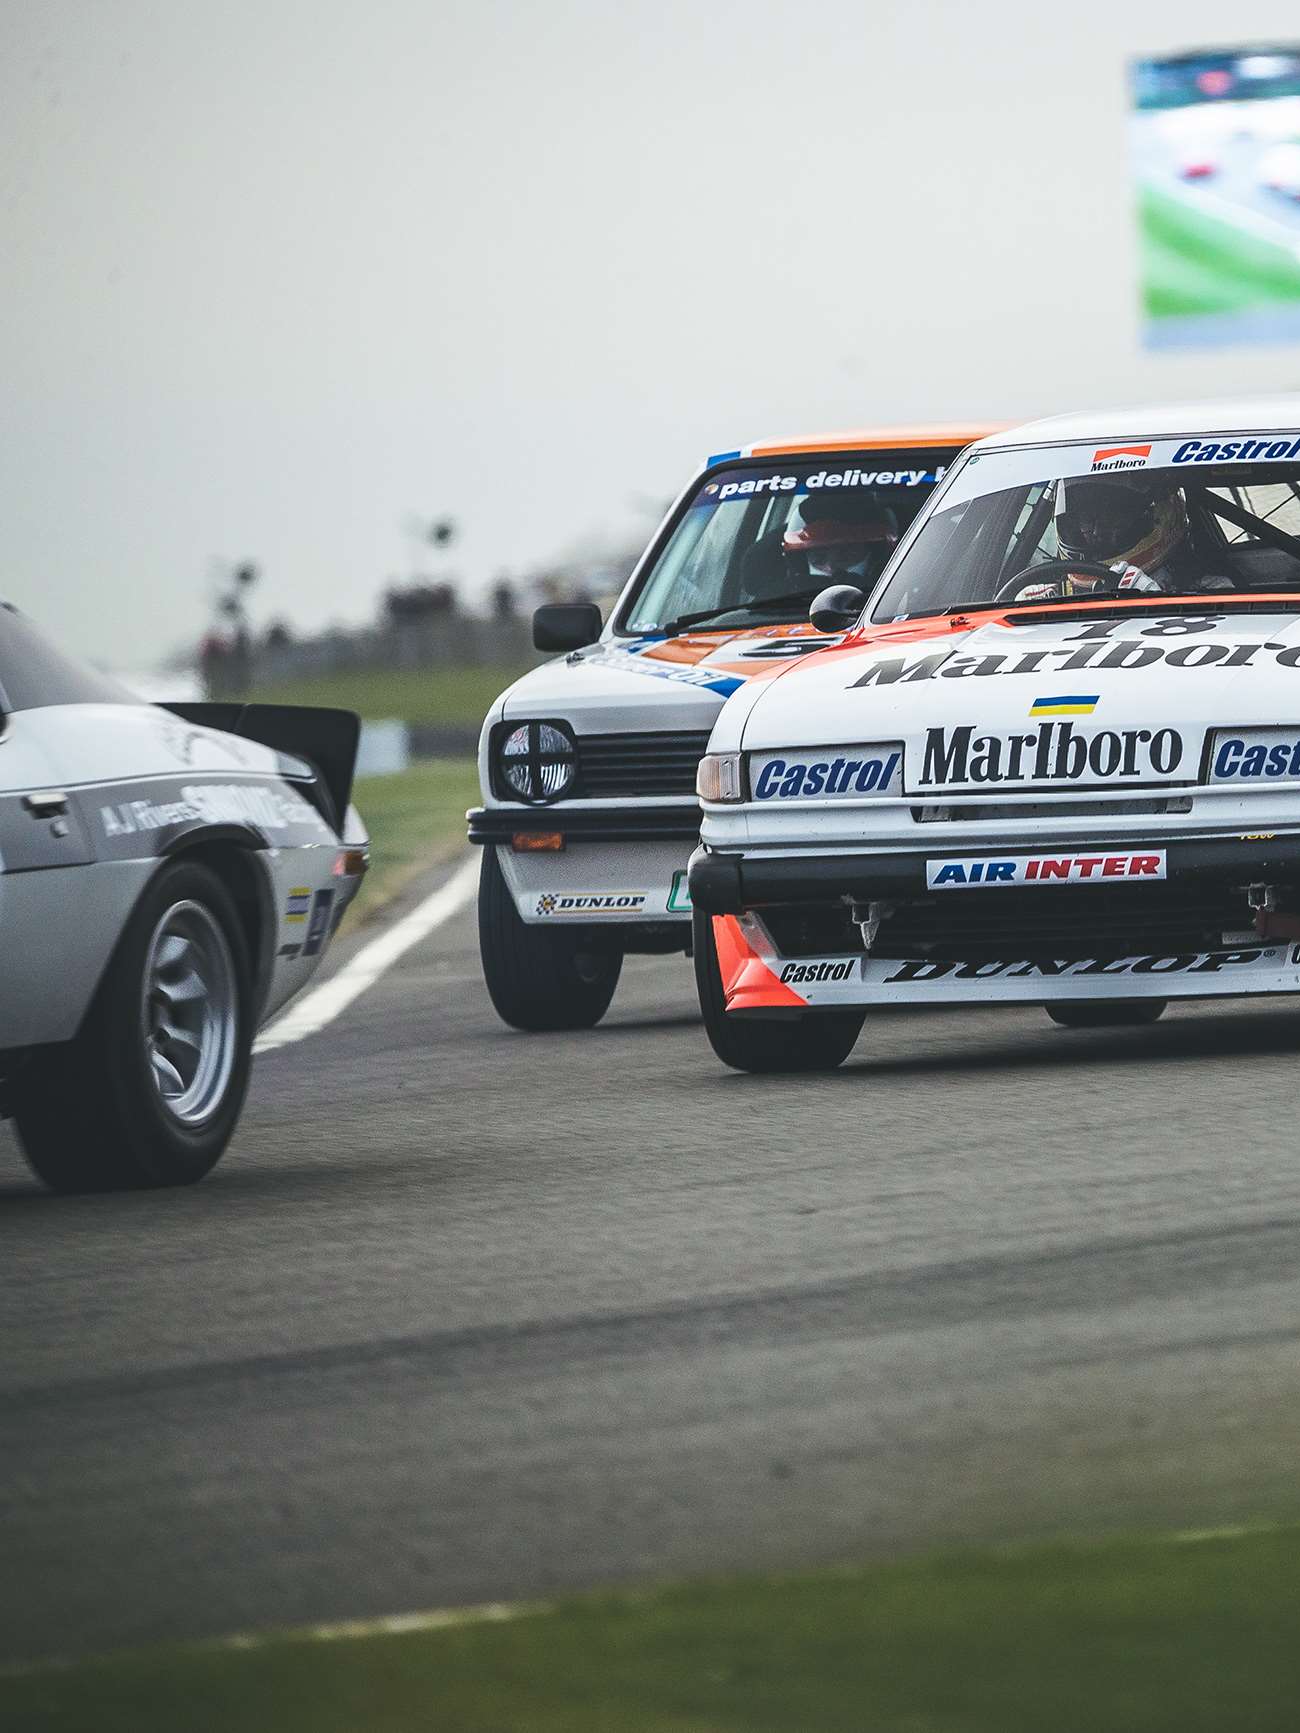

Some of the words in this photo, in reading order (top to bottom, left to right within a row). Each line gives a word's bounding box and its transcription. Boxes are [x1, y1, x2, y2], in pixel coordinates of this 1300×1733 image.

[1090, 459, 1146, 472] Marlboro
[718, 474, 797, 499] parts
[805, 469, 927, 488] delivery
[1062, 615, 1228, 641] 18
[918, 721, 1184, 785] Marlboro
[755, 753, 901, 799] Castrol
[933, 862, 1017, 885] AIR
[1025, 856, 1161, 880] INTER
[558, 896, 646, 908] DUNLOP
[780, 960, 856, 984] Castrol
[881, 950, 1264, 984] DUNLOP
